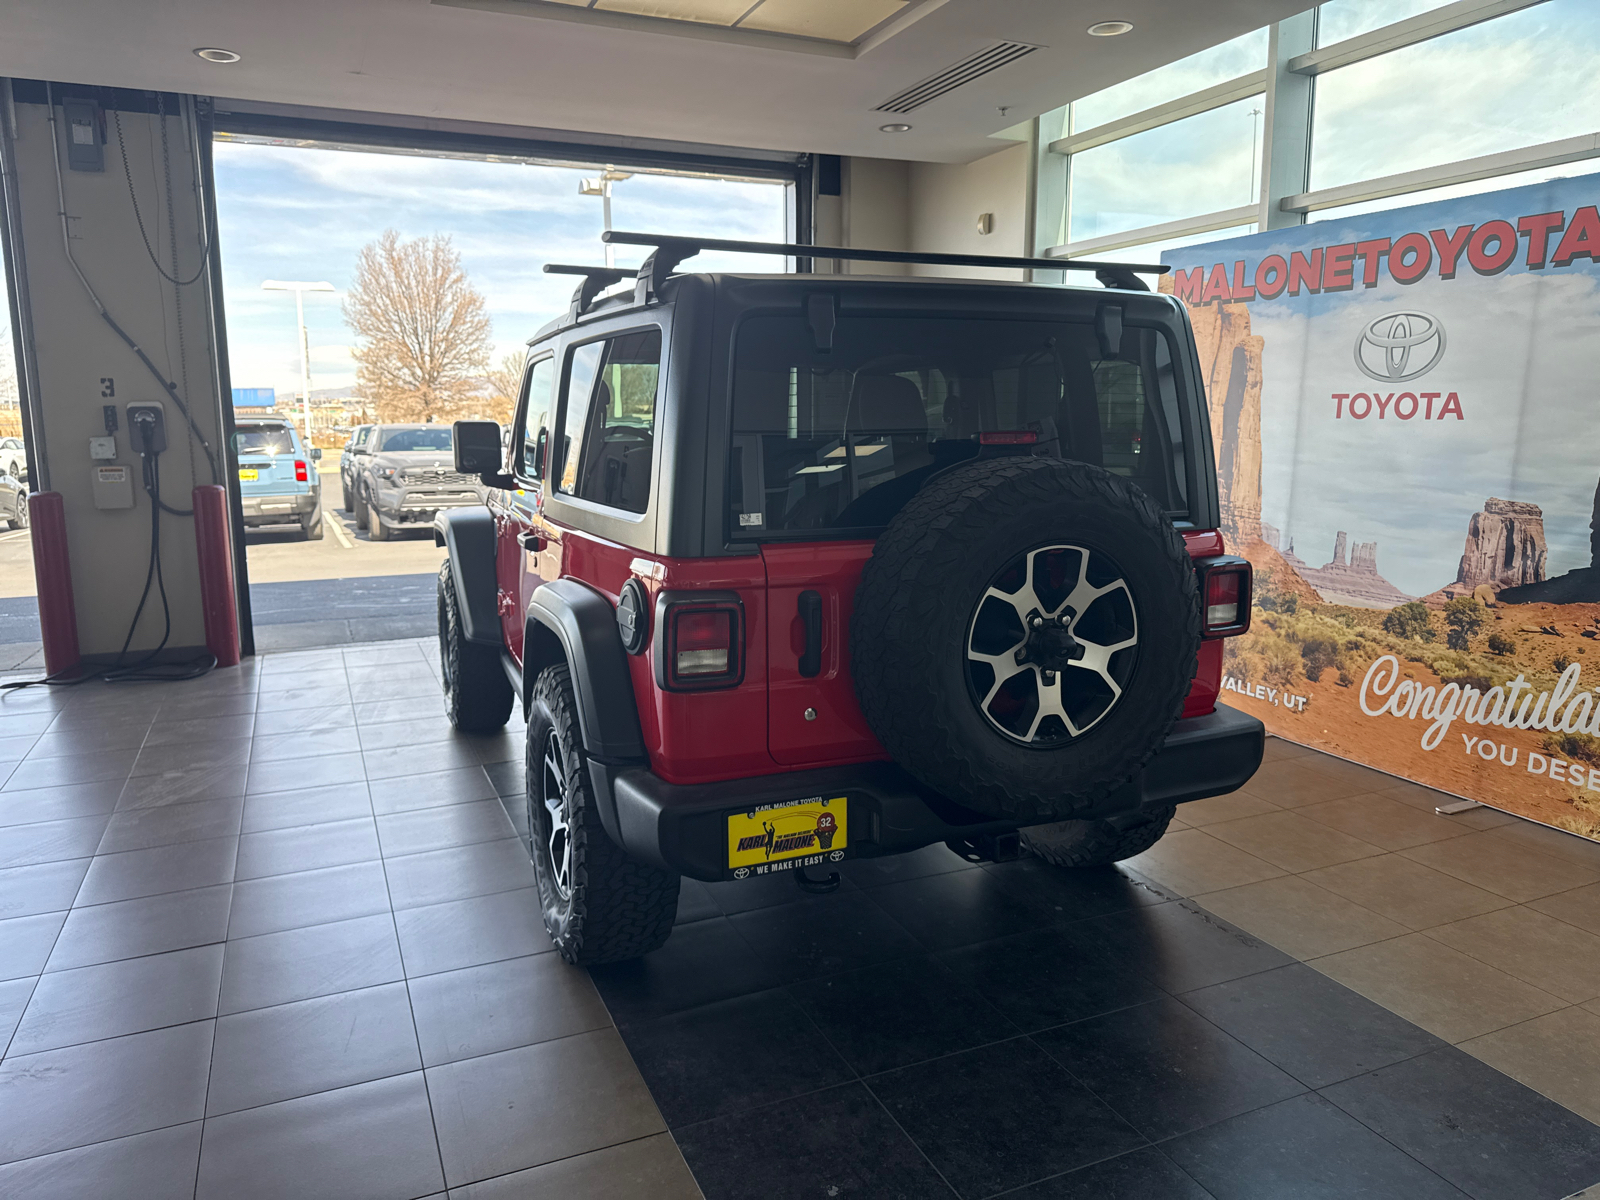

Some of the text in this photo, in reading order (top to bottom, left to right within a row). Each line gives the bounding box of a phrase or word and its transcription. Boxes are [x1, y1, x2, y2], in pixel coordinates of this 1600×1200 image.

[1173, 205, 1600, 307] MALONETOYOTA
[100, 377, 115, 397] 3
[1331, 391, 1464, 421] TOYOTA
[1283, 692, 1306, 712] UT
[1461, 733, 1518, 767] YOU
[773, 799, 799, 810] MALONE
[800, 797, 822, 805] TOYOTA
[820, 817, 832, 828] 32
[737, 834, 815, 854] KARL MALONE
[756, 855, 824, 875] WE MAKE IT EASY
